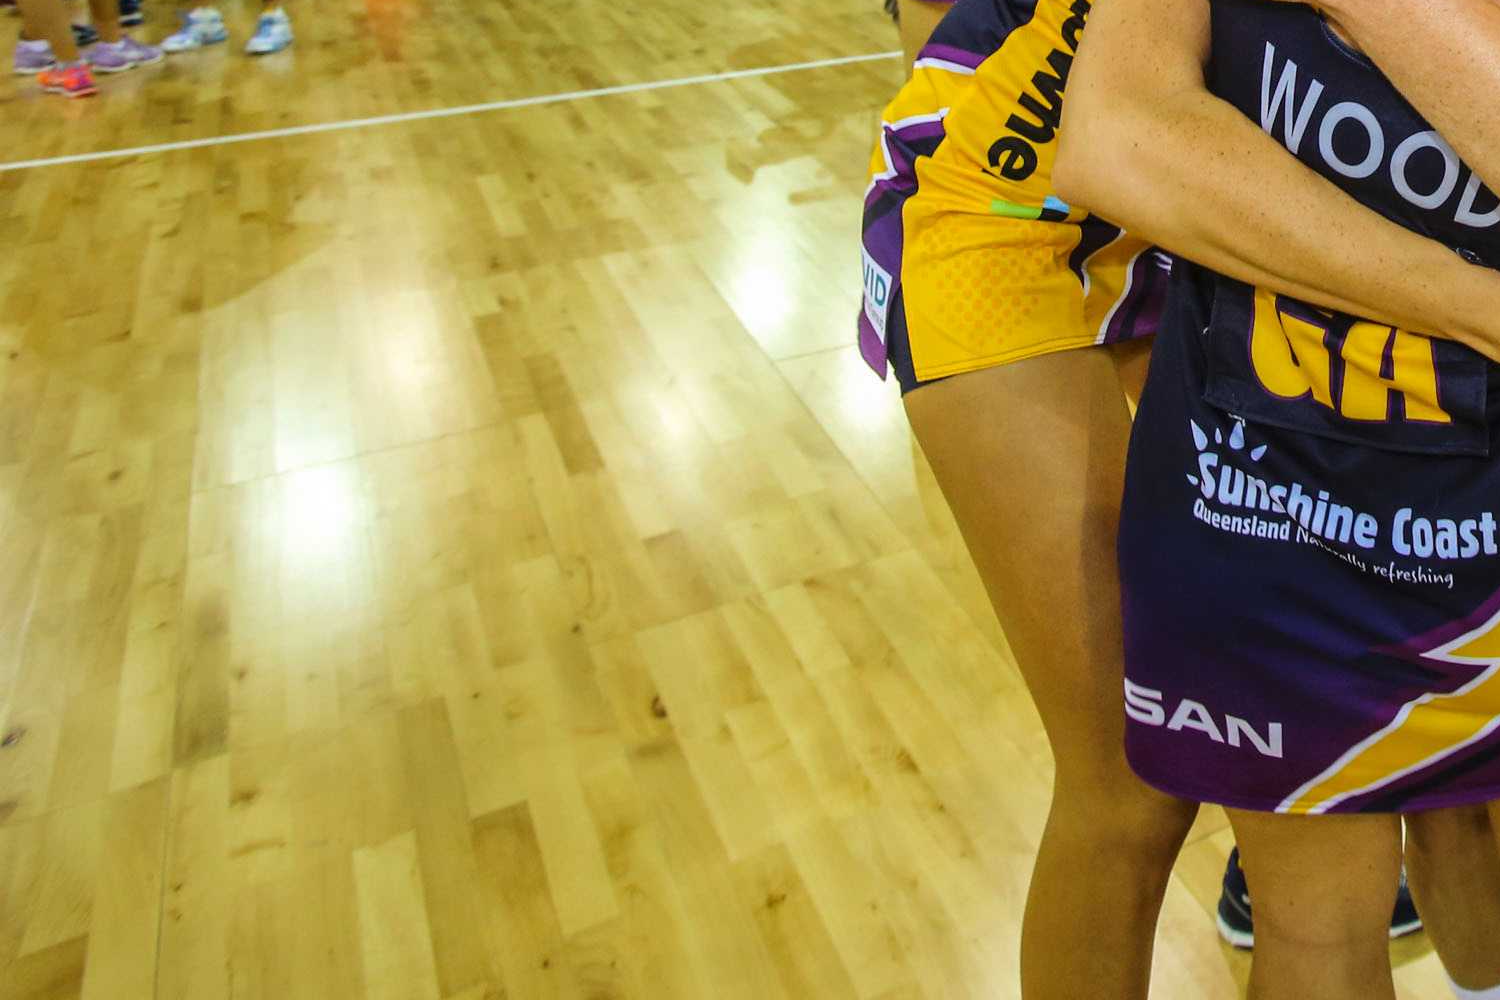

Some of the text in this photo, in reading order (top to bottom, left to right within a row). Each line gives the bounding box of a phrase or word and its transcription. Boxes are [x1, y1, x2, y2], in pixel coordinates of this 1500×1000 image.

[1193, 498, 1291, 542] Queensland
[1373, 561, 1454, 589] refreshing
[1198, 451, 1499, 560] Sunshine Coast
